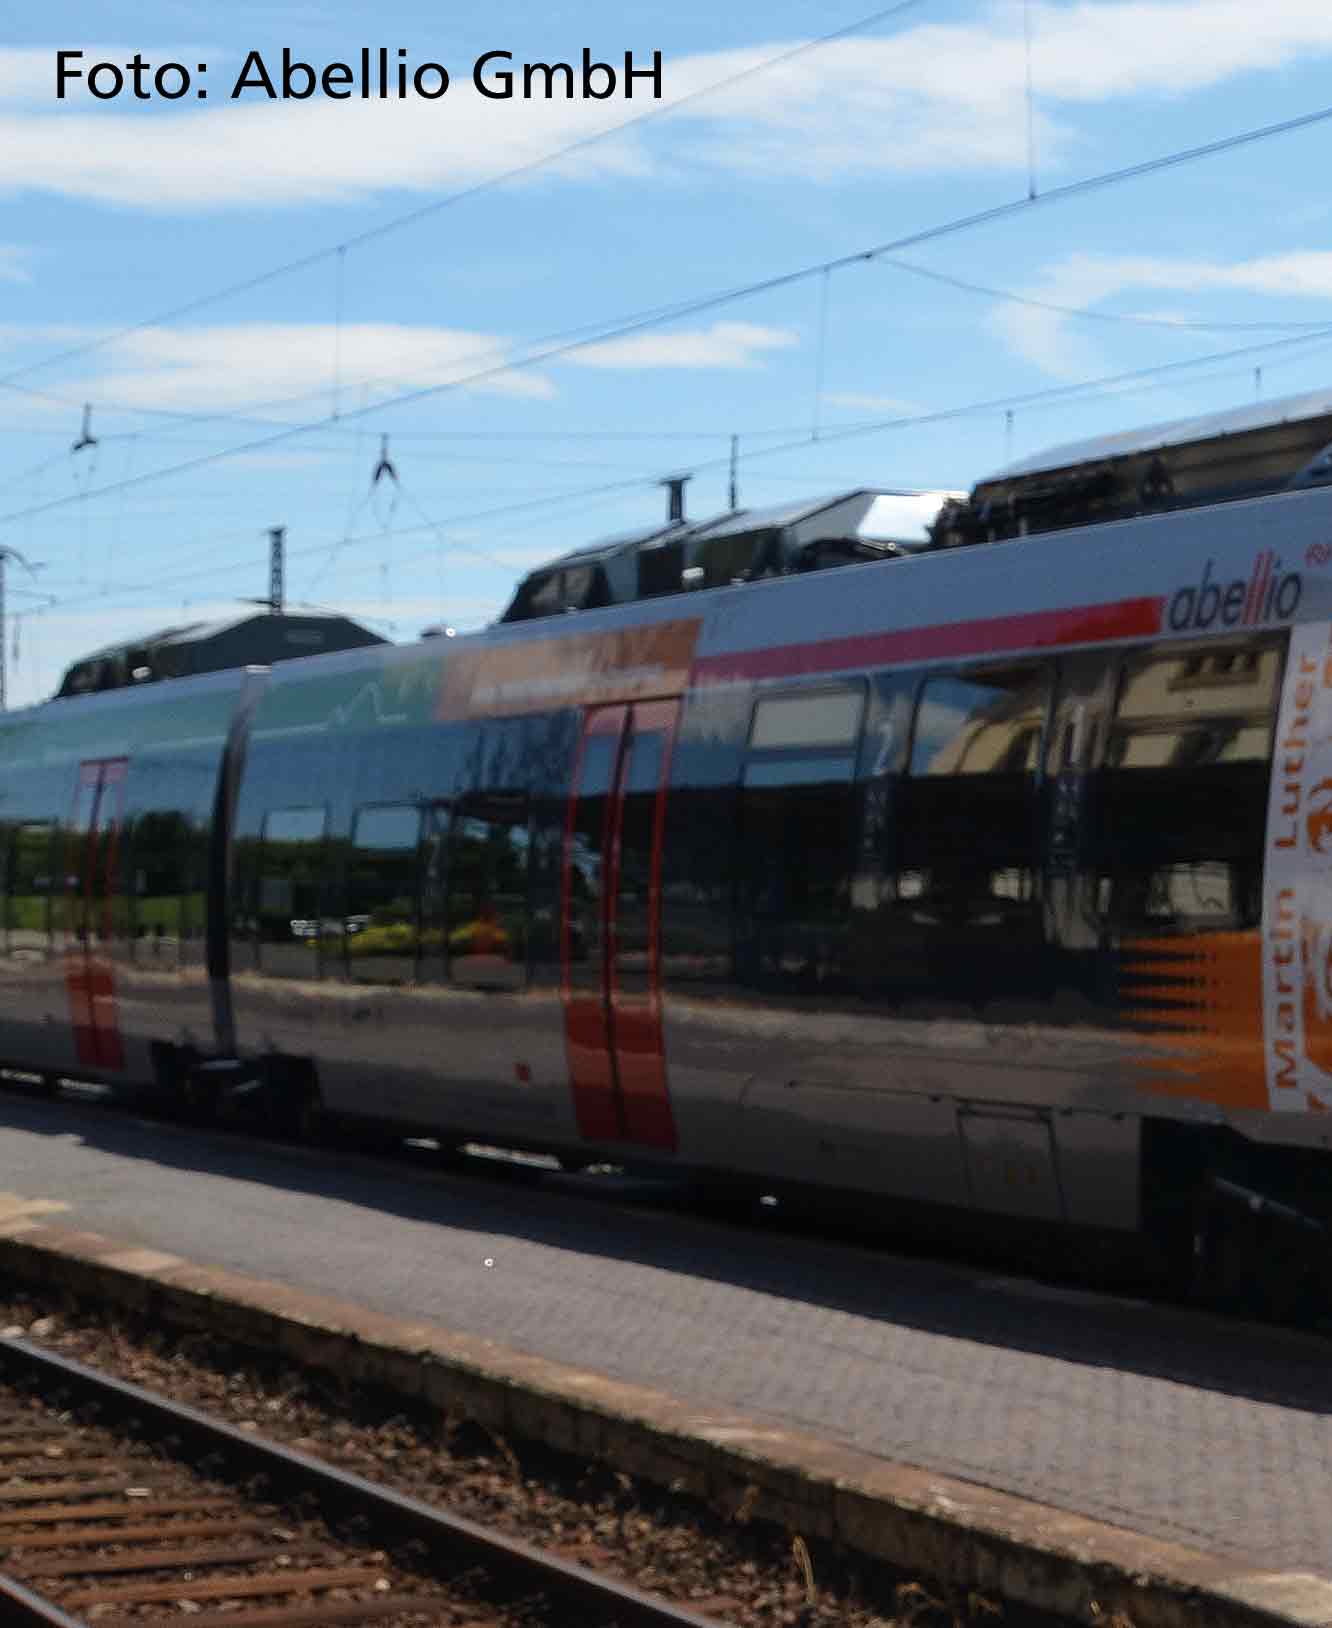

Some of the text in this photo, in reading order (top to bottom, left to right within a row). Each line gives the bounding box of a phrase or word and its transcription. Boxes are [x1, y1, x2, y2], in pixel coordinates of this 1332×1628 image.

[1169, 550, 1302, 631] abellio
[1269, 655, 1318, 1089] Martin Luther
